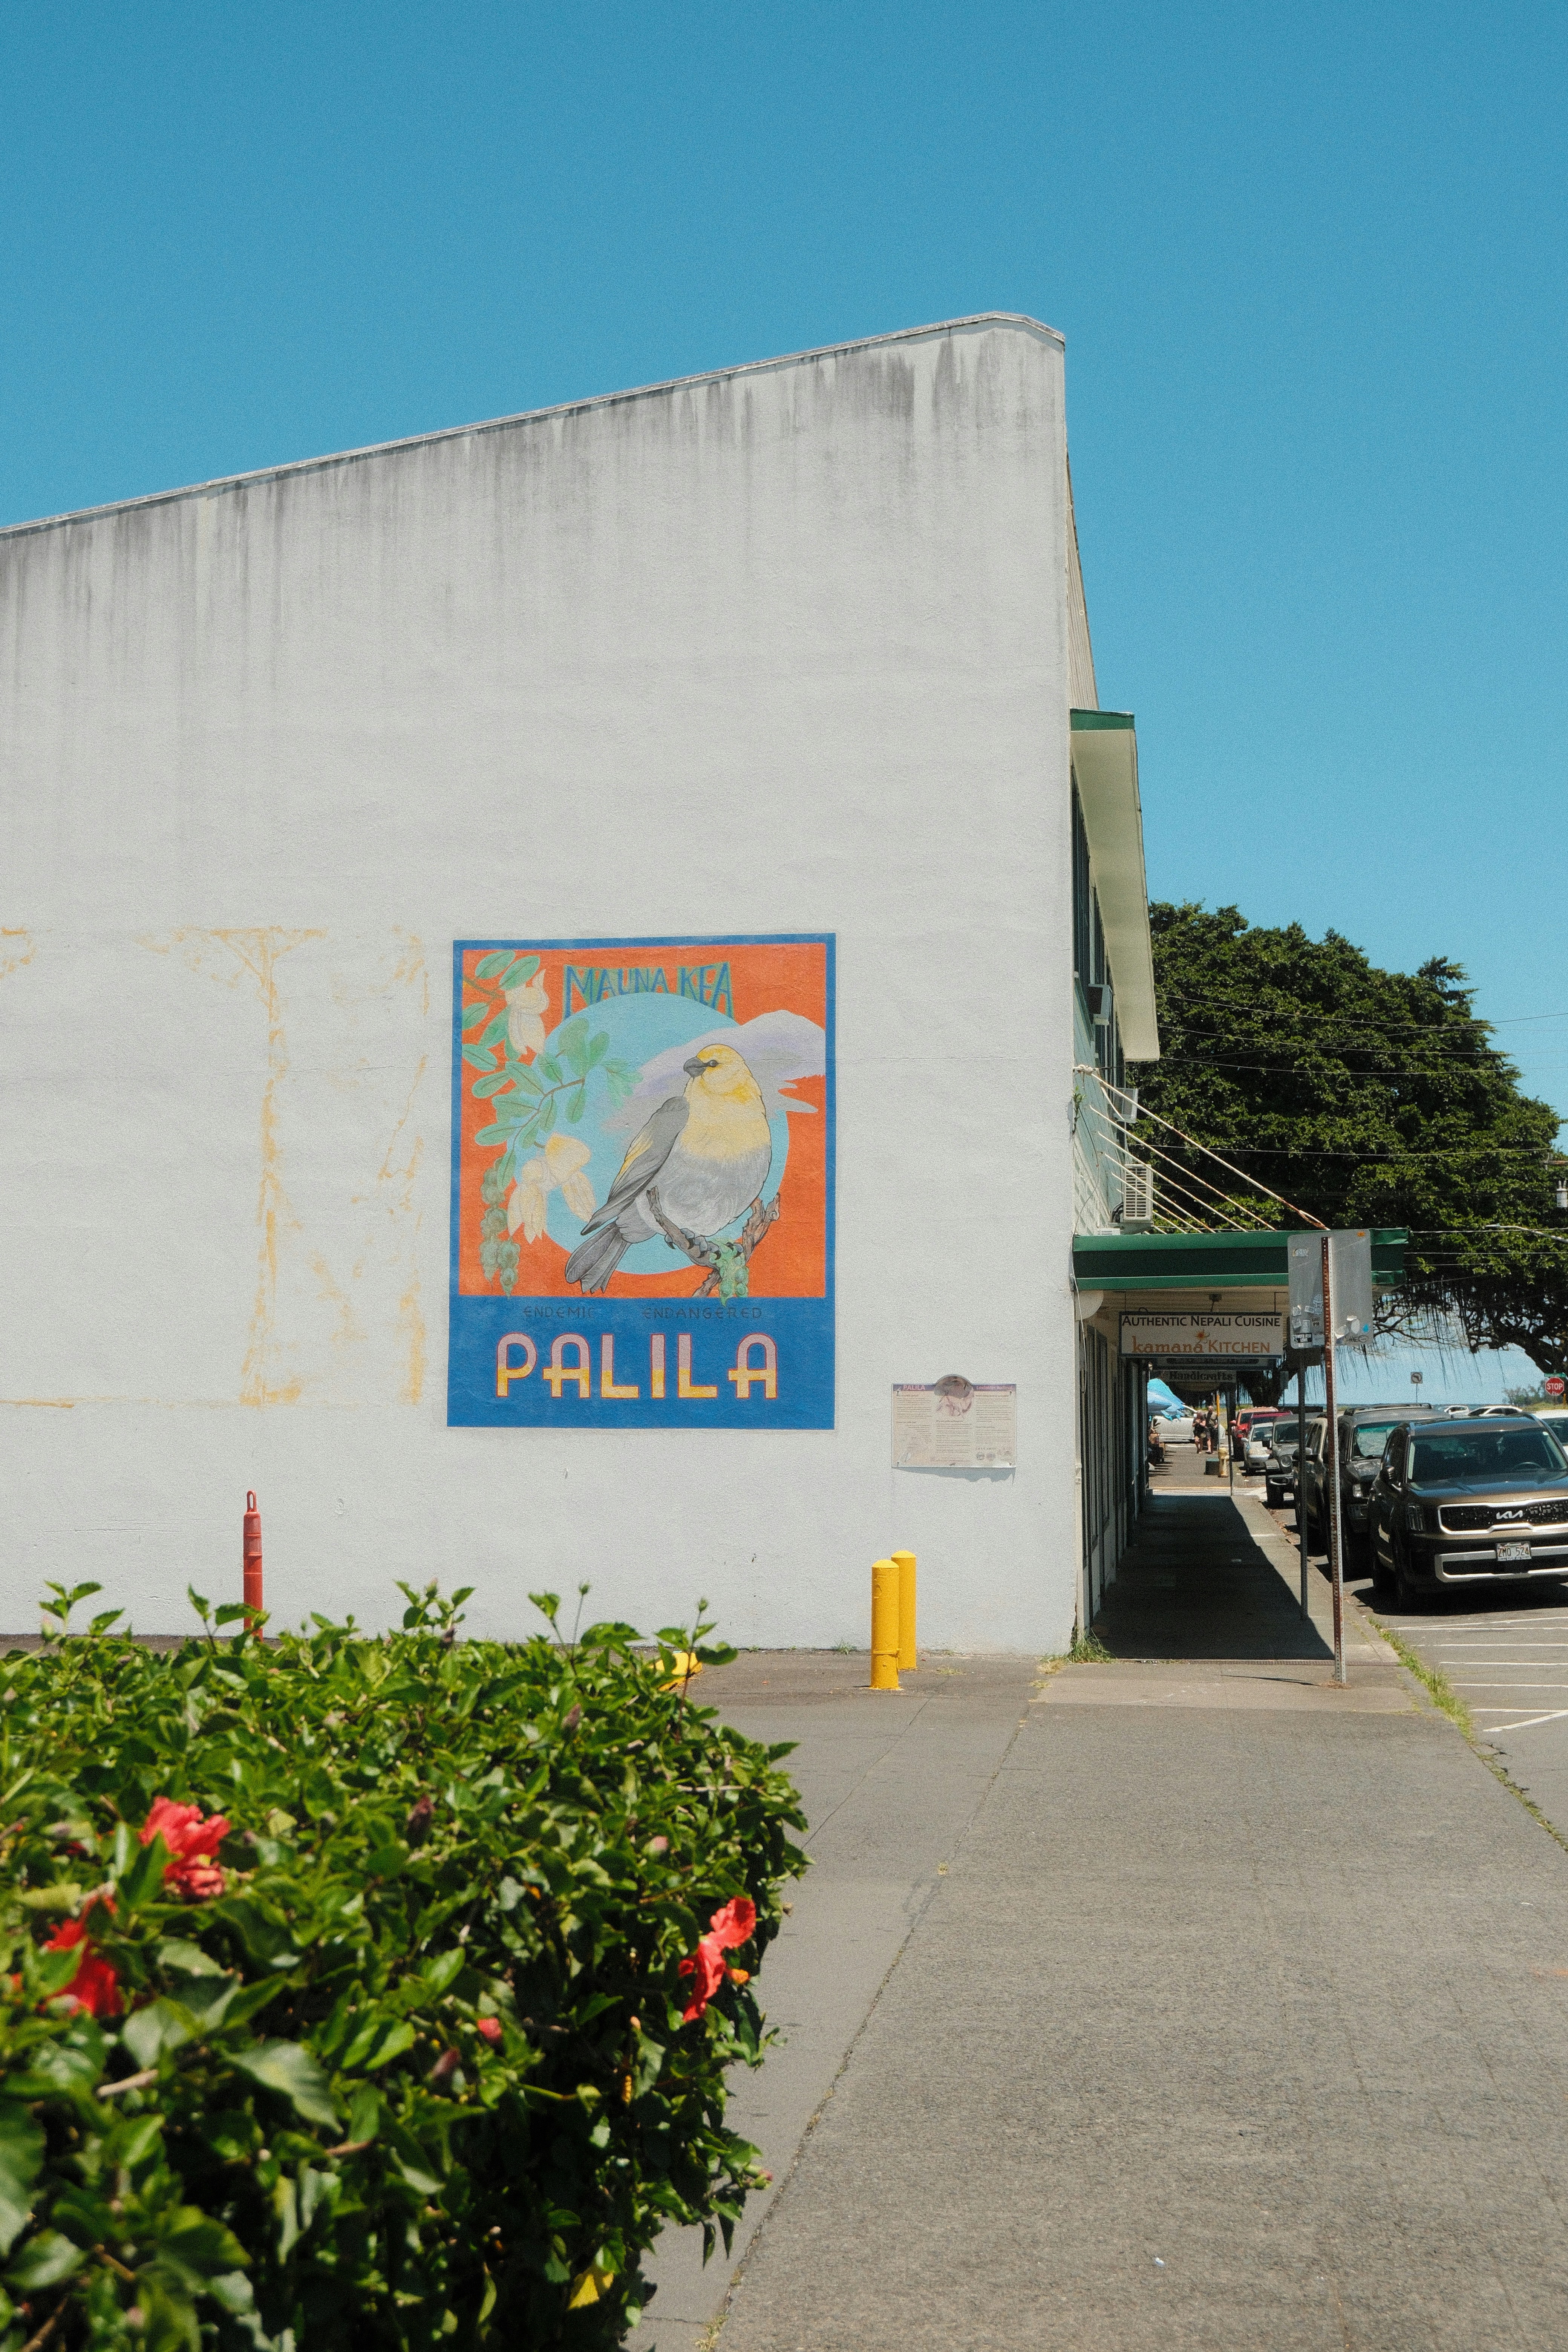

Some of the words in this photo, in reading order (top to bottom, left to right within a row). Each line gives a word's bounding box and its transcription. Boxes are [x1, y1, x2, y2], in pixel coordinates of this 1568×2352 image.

[563, 965, 670, 1019] MAUNA
[677, 961, 734, 1019] KEA
[522, 1305, 596, 1319] ENDEMIC
[642, 1305, 763, 1319] ENDANGERED
[1122, 1315, 1187, 1326] AUTHENTIC
[1191, 1315, 1231, 1326] NEPALI
[1234, 1315, 1280, 1327] CUISINE
[1208, 1340, 1271, 1353] KITCHEN
[496, 1331, 778, 1399] PALILA
[1169, 1371, 1233, 1380] Handicrafts
[1496, 1510, 1523, 1519] KIA
[1516, 1547, 1529, 1556] 524
